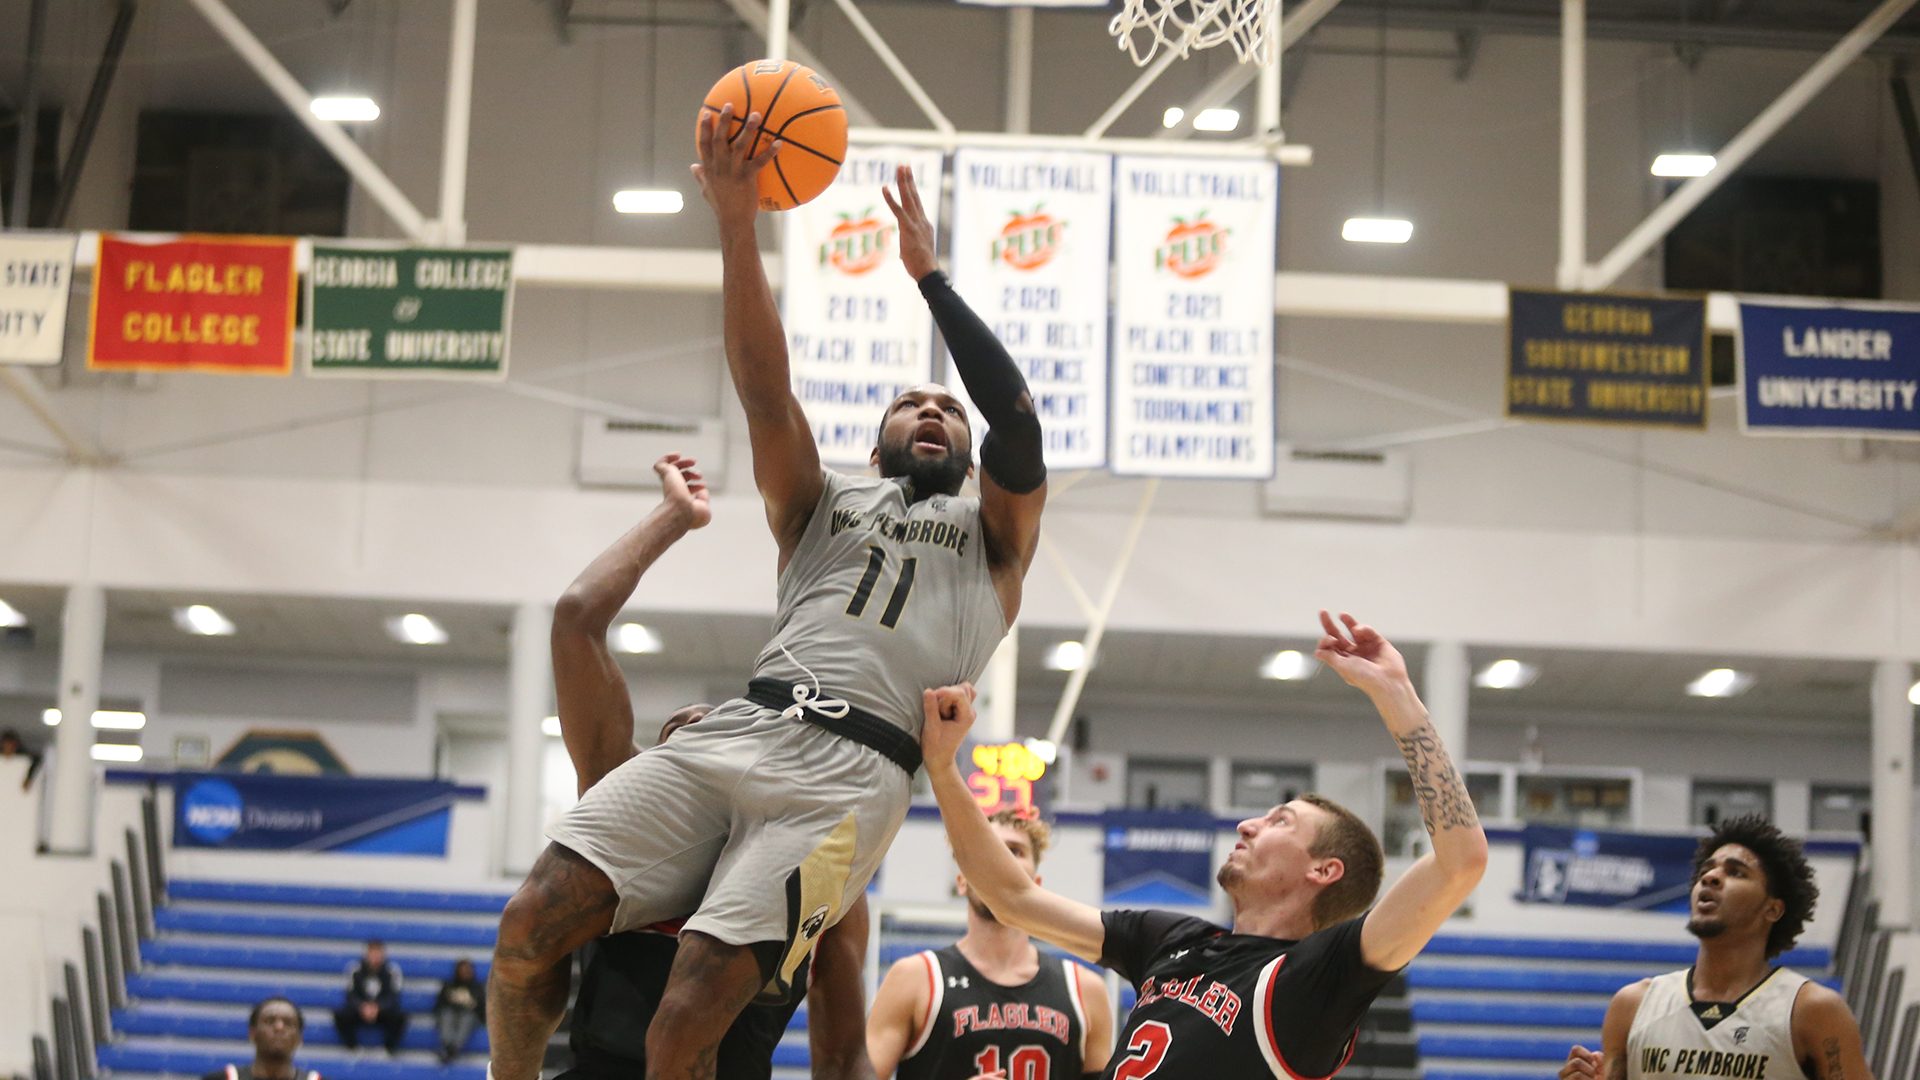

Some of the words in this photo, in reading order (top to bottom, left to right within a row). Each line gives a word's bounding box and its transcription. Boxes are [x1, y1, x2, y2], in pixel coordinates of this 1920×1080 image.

[970, 164, 1100, 193] VOLLEYBALL
[1131, 171, 1263, 201] VOLLEYBALL
[7, 261, 62, 288] STATE
[125, 260, 264, 295] FLAGLER
[314, 255, 398, 288] GEORGIA
[414, 258, 510, 290] COLLEGE
[829, 294, 888, 321] 2019
[1003, 286, 1061, 311] 2020
[1168, 293, 1221, 319] 2021
[122, 310, 261, 346] COLLEGE
[994, 321, 1030, 345] ACH
[1047, 323, 1095, 348] BELT
[1128, 325, 1194, 352] PEACH
[1209, 328, 1258, 356] BELT
[1783, 325, 1892, 361] LANDER
[313, 329, 372, 361] STATE
[385, 329, 503, 362] UNIVERSITY
[793, 333, 855, 364] PEACH
[870, 339, 918, 366] BELT
[1133, 363, 1250, 390] CONFERENCE
[1134, 397, 1255, 424] TOURNAMENT
[1758, 376, 1918, 412] UNIVERSITY
[1130, 433, 1256, 460] CHAMPIONS
[868, 511, 969, 558] PEMBROKE
[844, 544, 918, 631] 11
[952, 1002, 1070, 1045] FLAGLER
[1113, 1019, 1173, 1080] 2
[1641, 1046, 1671, 1074] UNC
[1672, 1048, 1770, 1080] PEMBROKE
